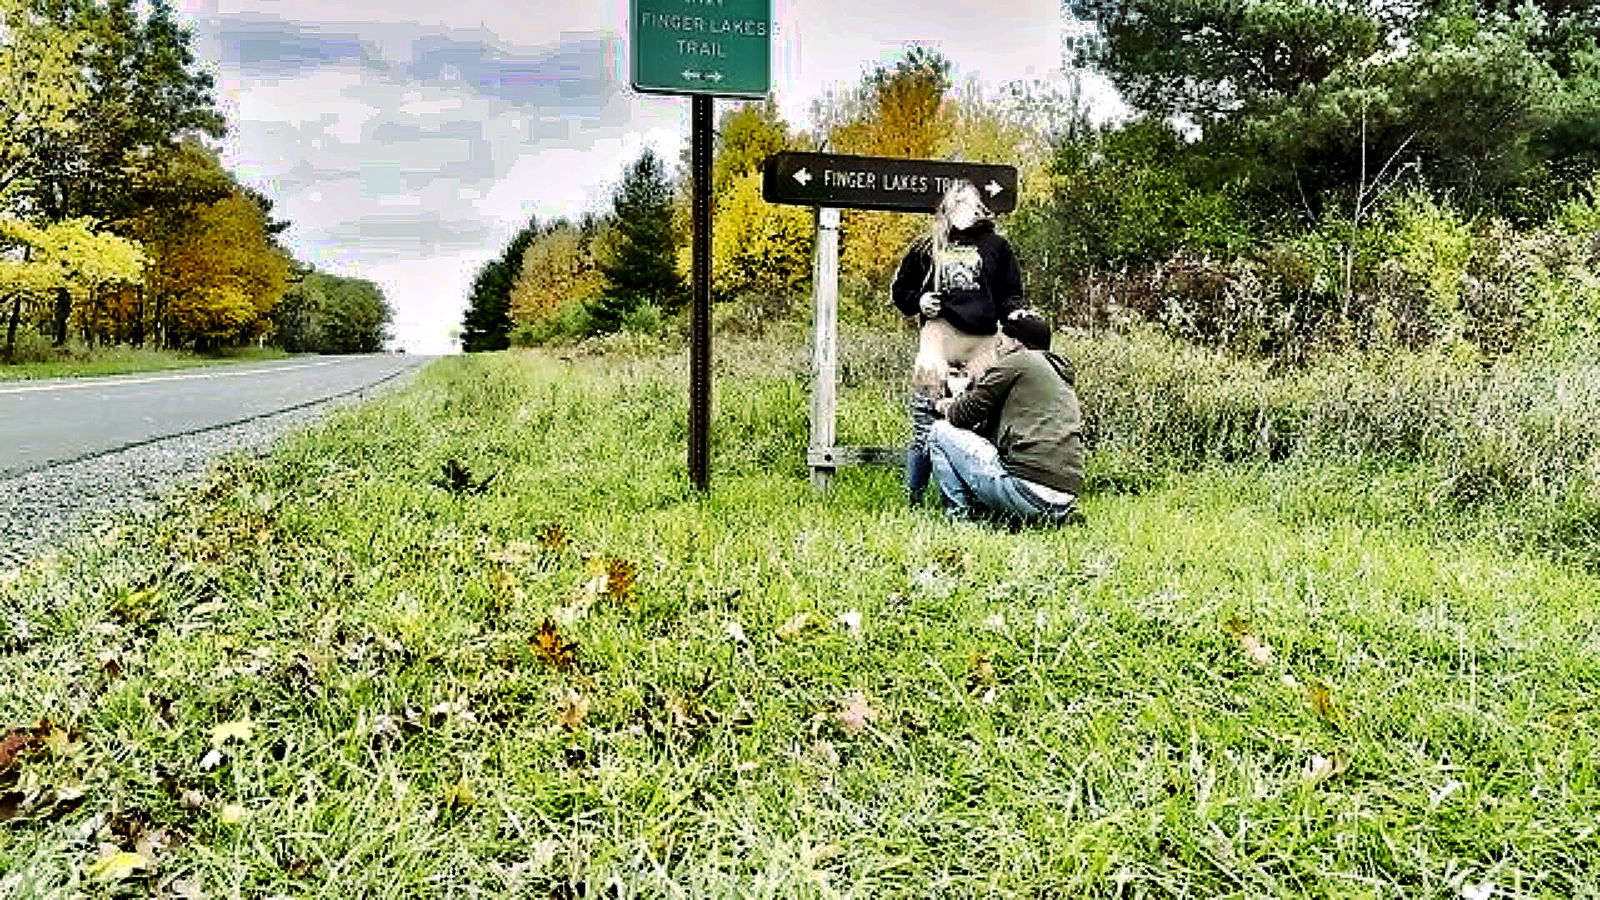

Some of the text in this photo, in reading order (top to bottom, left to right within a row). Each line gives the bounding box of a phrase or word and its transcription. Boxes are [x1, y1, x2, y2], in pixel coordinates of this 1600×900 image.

[642, 12, 767, 36] FINGER LAKES
[676, 39, 726, 58] TRAIL
[824, 169, 876, 190] FINGER
[883, 173, 928, 193] LAKES
